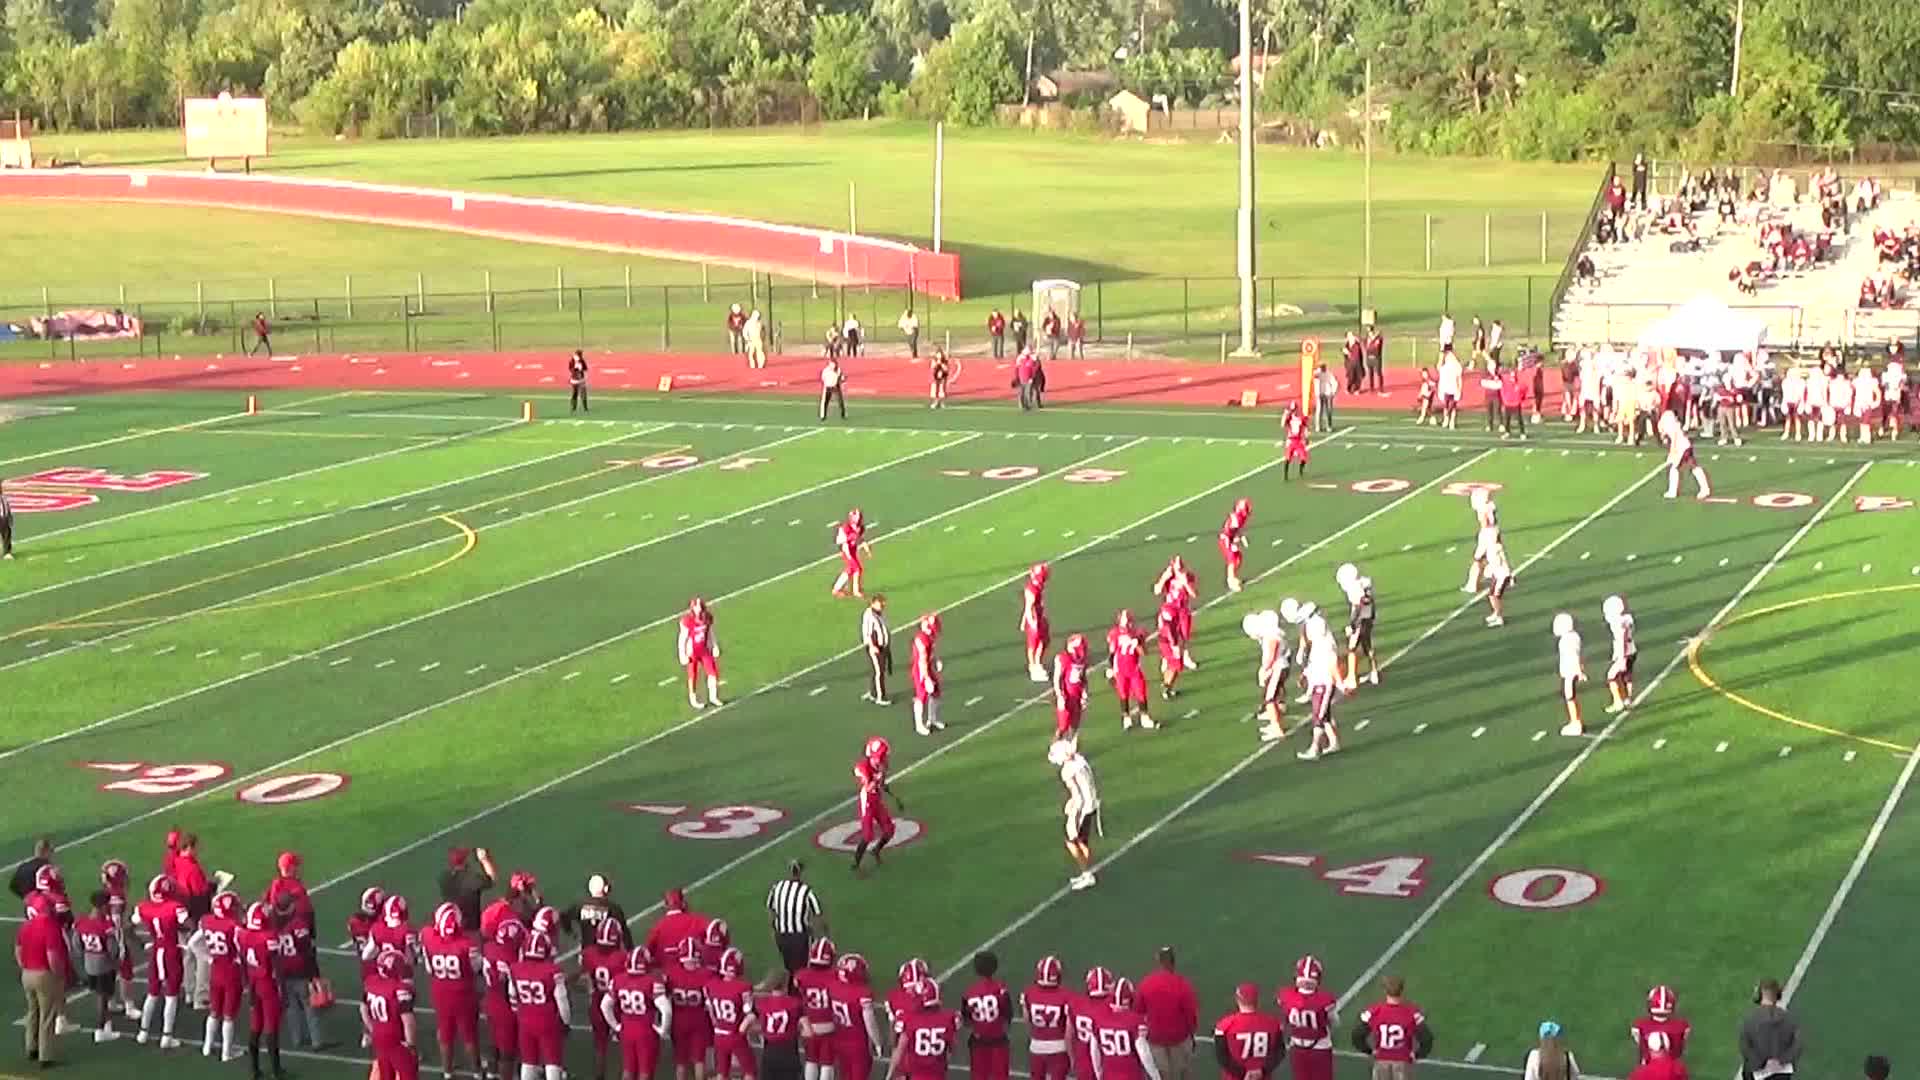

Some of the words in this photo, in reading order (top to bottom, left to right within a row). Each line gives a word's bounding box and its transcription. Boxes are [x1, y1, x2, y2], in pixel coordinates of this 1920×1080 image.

[152, 917, 164, 939] 1
[431, 954, 461, 980] 99
[515, 979, 546, 1005] 53
[618, 988, 647, 1016] 28
[806, 987, 829, 1010] 31
[713, 997, 737, 1024] 18
[967, 994, 1000, 1023] 38
[1030, 1003, 1061, 1028] 57
[914, 1027, 947, 1057] 65
[1099, 1028, 1132, 1056] 50
[1236, 1031, 1269, 1059] 78
[1379, 1023, 1405, 1050] 12
